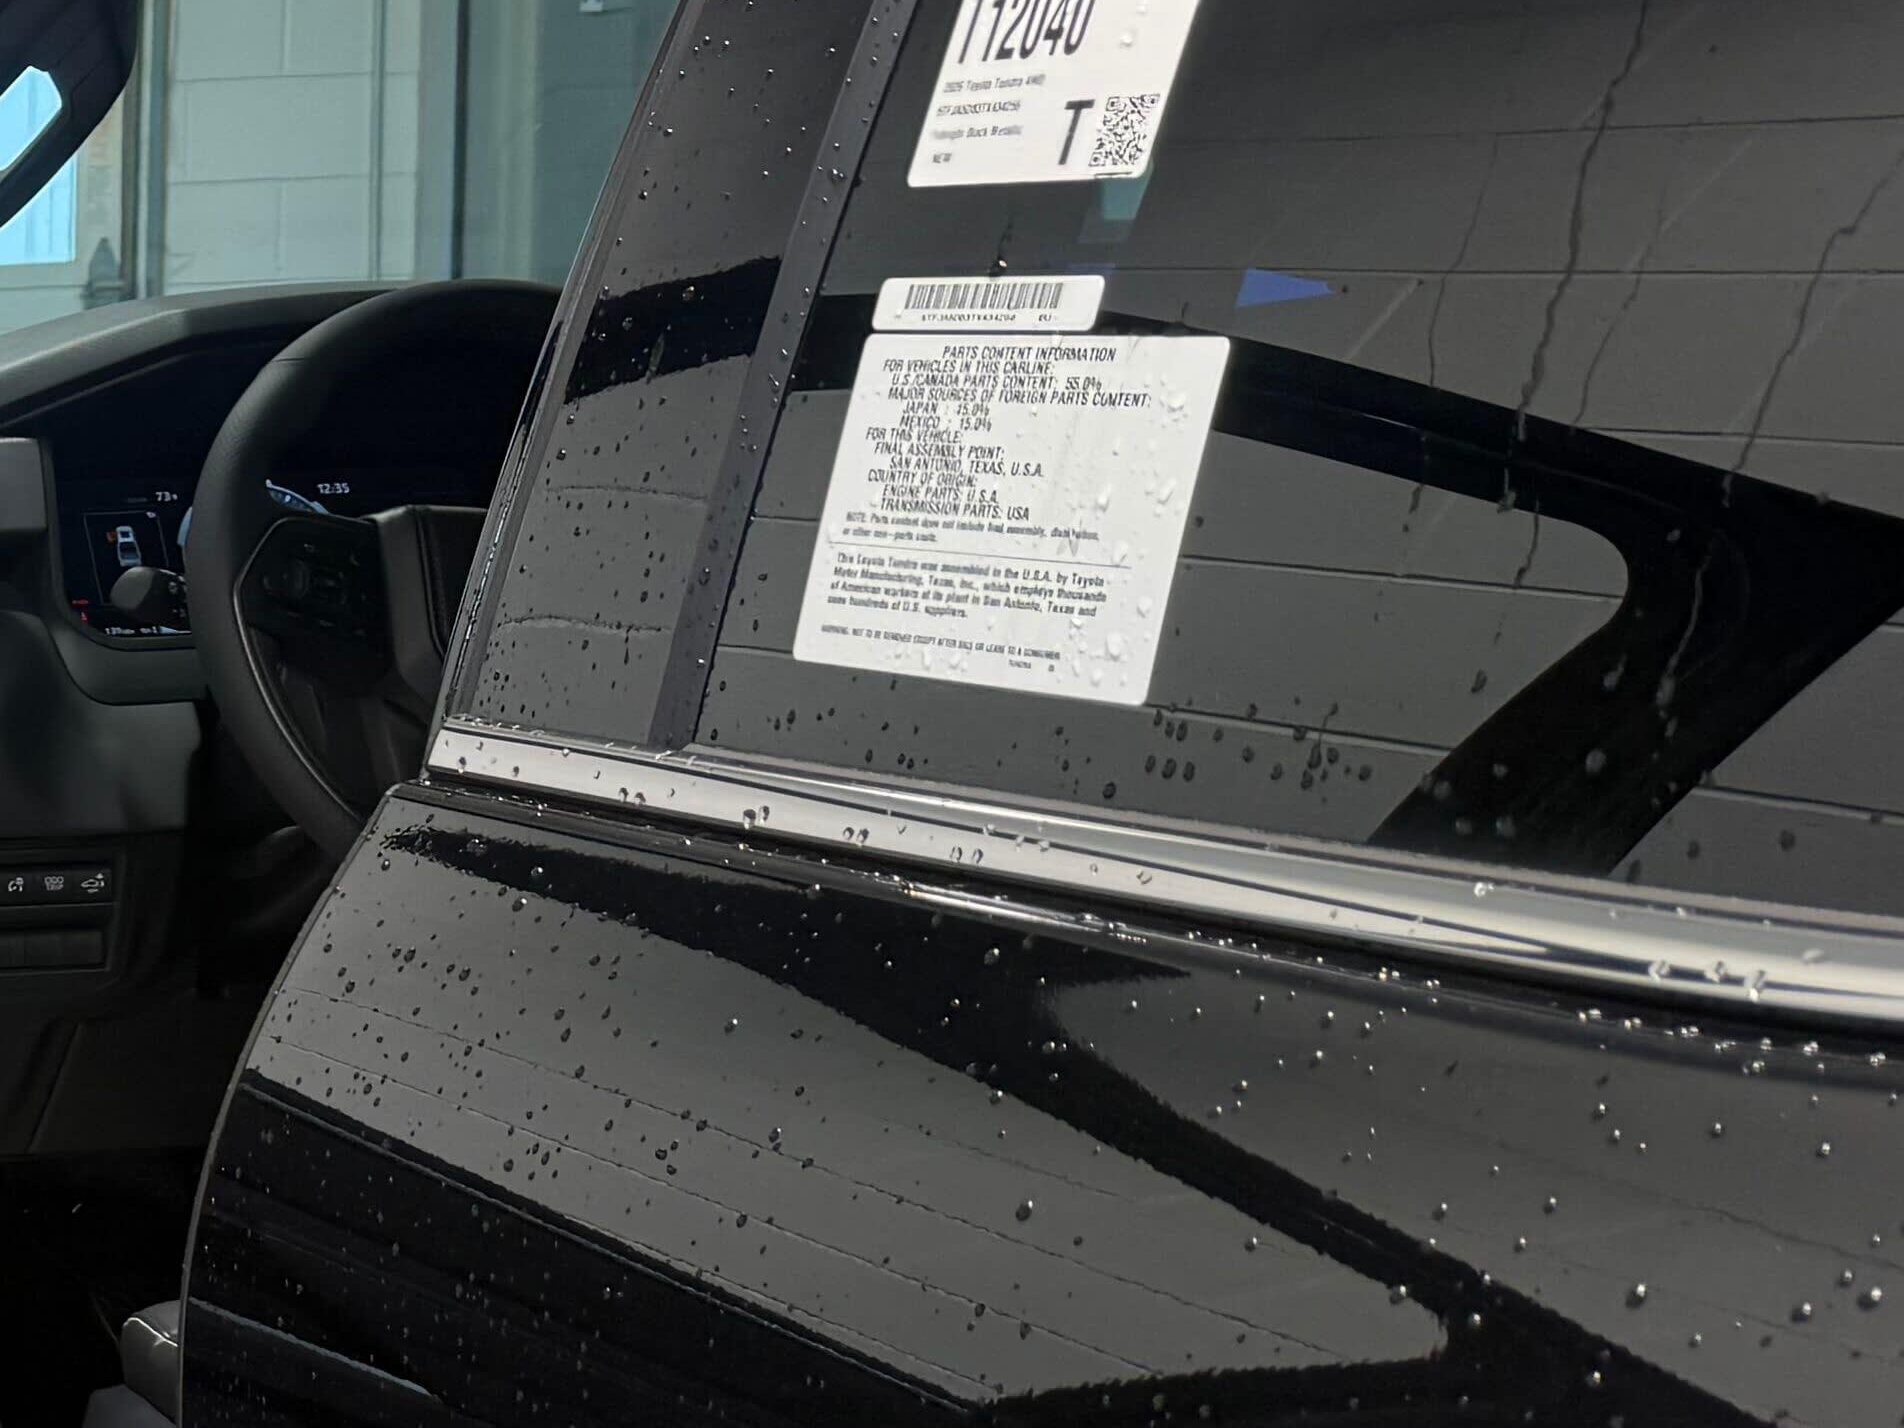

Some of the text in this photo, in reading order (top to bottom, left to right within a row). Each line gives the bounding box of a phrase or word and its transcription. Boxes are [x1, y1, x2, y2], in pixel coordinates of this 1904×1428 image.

[1058, 99, 1095, 165] T
[942, 345, 1117, 362] PARTS CONTENT INFORMATION
[883, 359, 903, 372] FOR
[906, 359, 956, 373] VEHICLES
[959, 360, 973, 373] IN
[976, 360, 999, 373] THIS
[963, 374, 998, 389] PARTS
[888, 387, 924, 401] MAJOR
[928, 387, 977, 402] SOURCES
[980, 388, 995, 403] OF
[998, 389, 1047, 405] FOREIGN
[1050, 391, 1089, 406] PARTS
[902, 401, 938, 415] JAPAN
[900, 414, 940, 429] MEXICO
[866, 427, 885, 440] FOR
[891, 428, 912, 441] THIS
[874, 441, 903, 455] FINAL
[907, 442, 966, 458] ASSEMBLY
[890, 456, 910, 470] SAN
[868, 468, 917, 483] COUNTRY
[920, 470, 934, 484] OF
[883, 483, 922, 499] ENGINE
[880, 497, 959, 516] TRANSMISSION
[1007, 504, 1030, 521] USA
